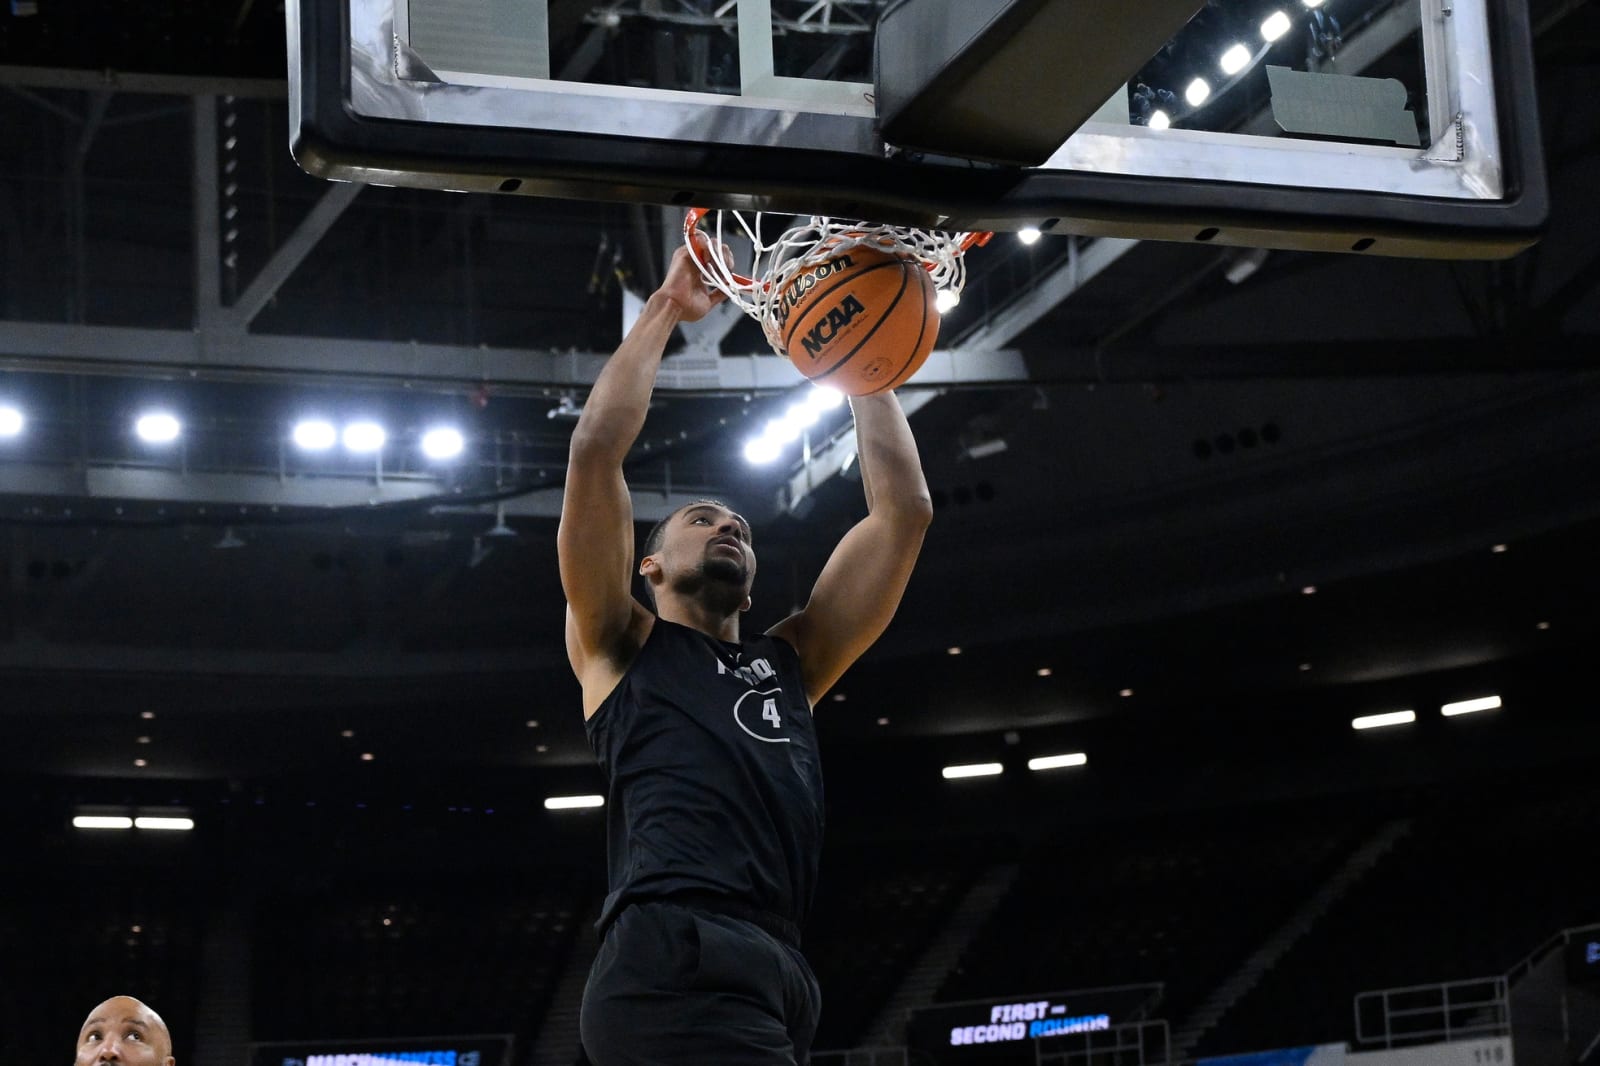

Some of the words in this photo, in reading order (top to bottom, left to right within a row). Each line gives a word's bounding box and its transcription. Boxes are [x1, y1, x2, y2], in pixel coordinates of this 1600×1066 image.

[800, 293, 865, 359] NCAA
[762, 698, 781, 729] 4
[991, 1001, 1049, 1023] FIRST
[950, 1022, 1027, 1046] SECOND
